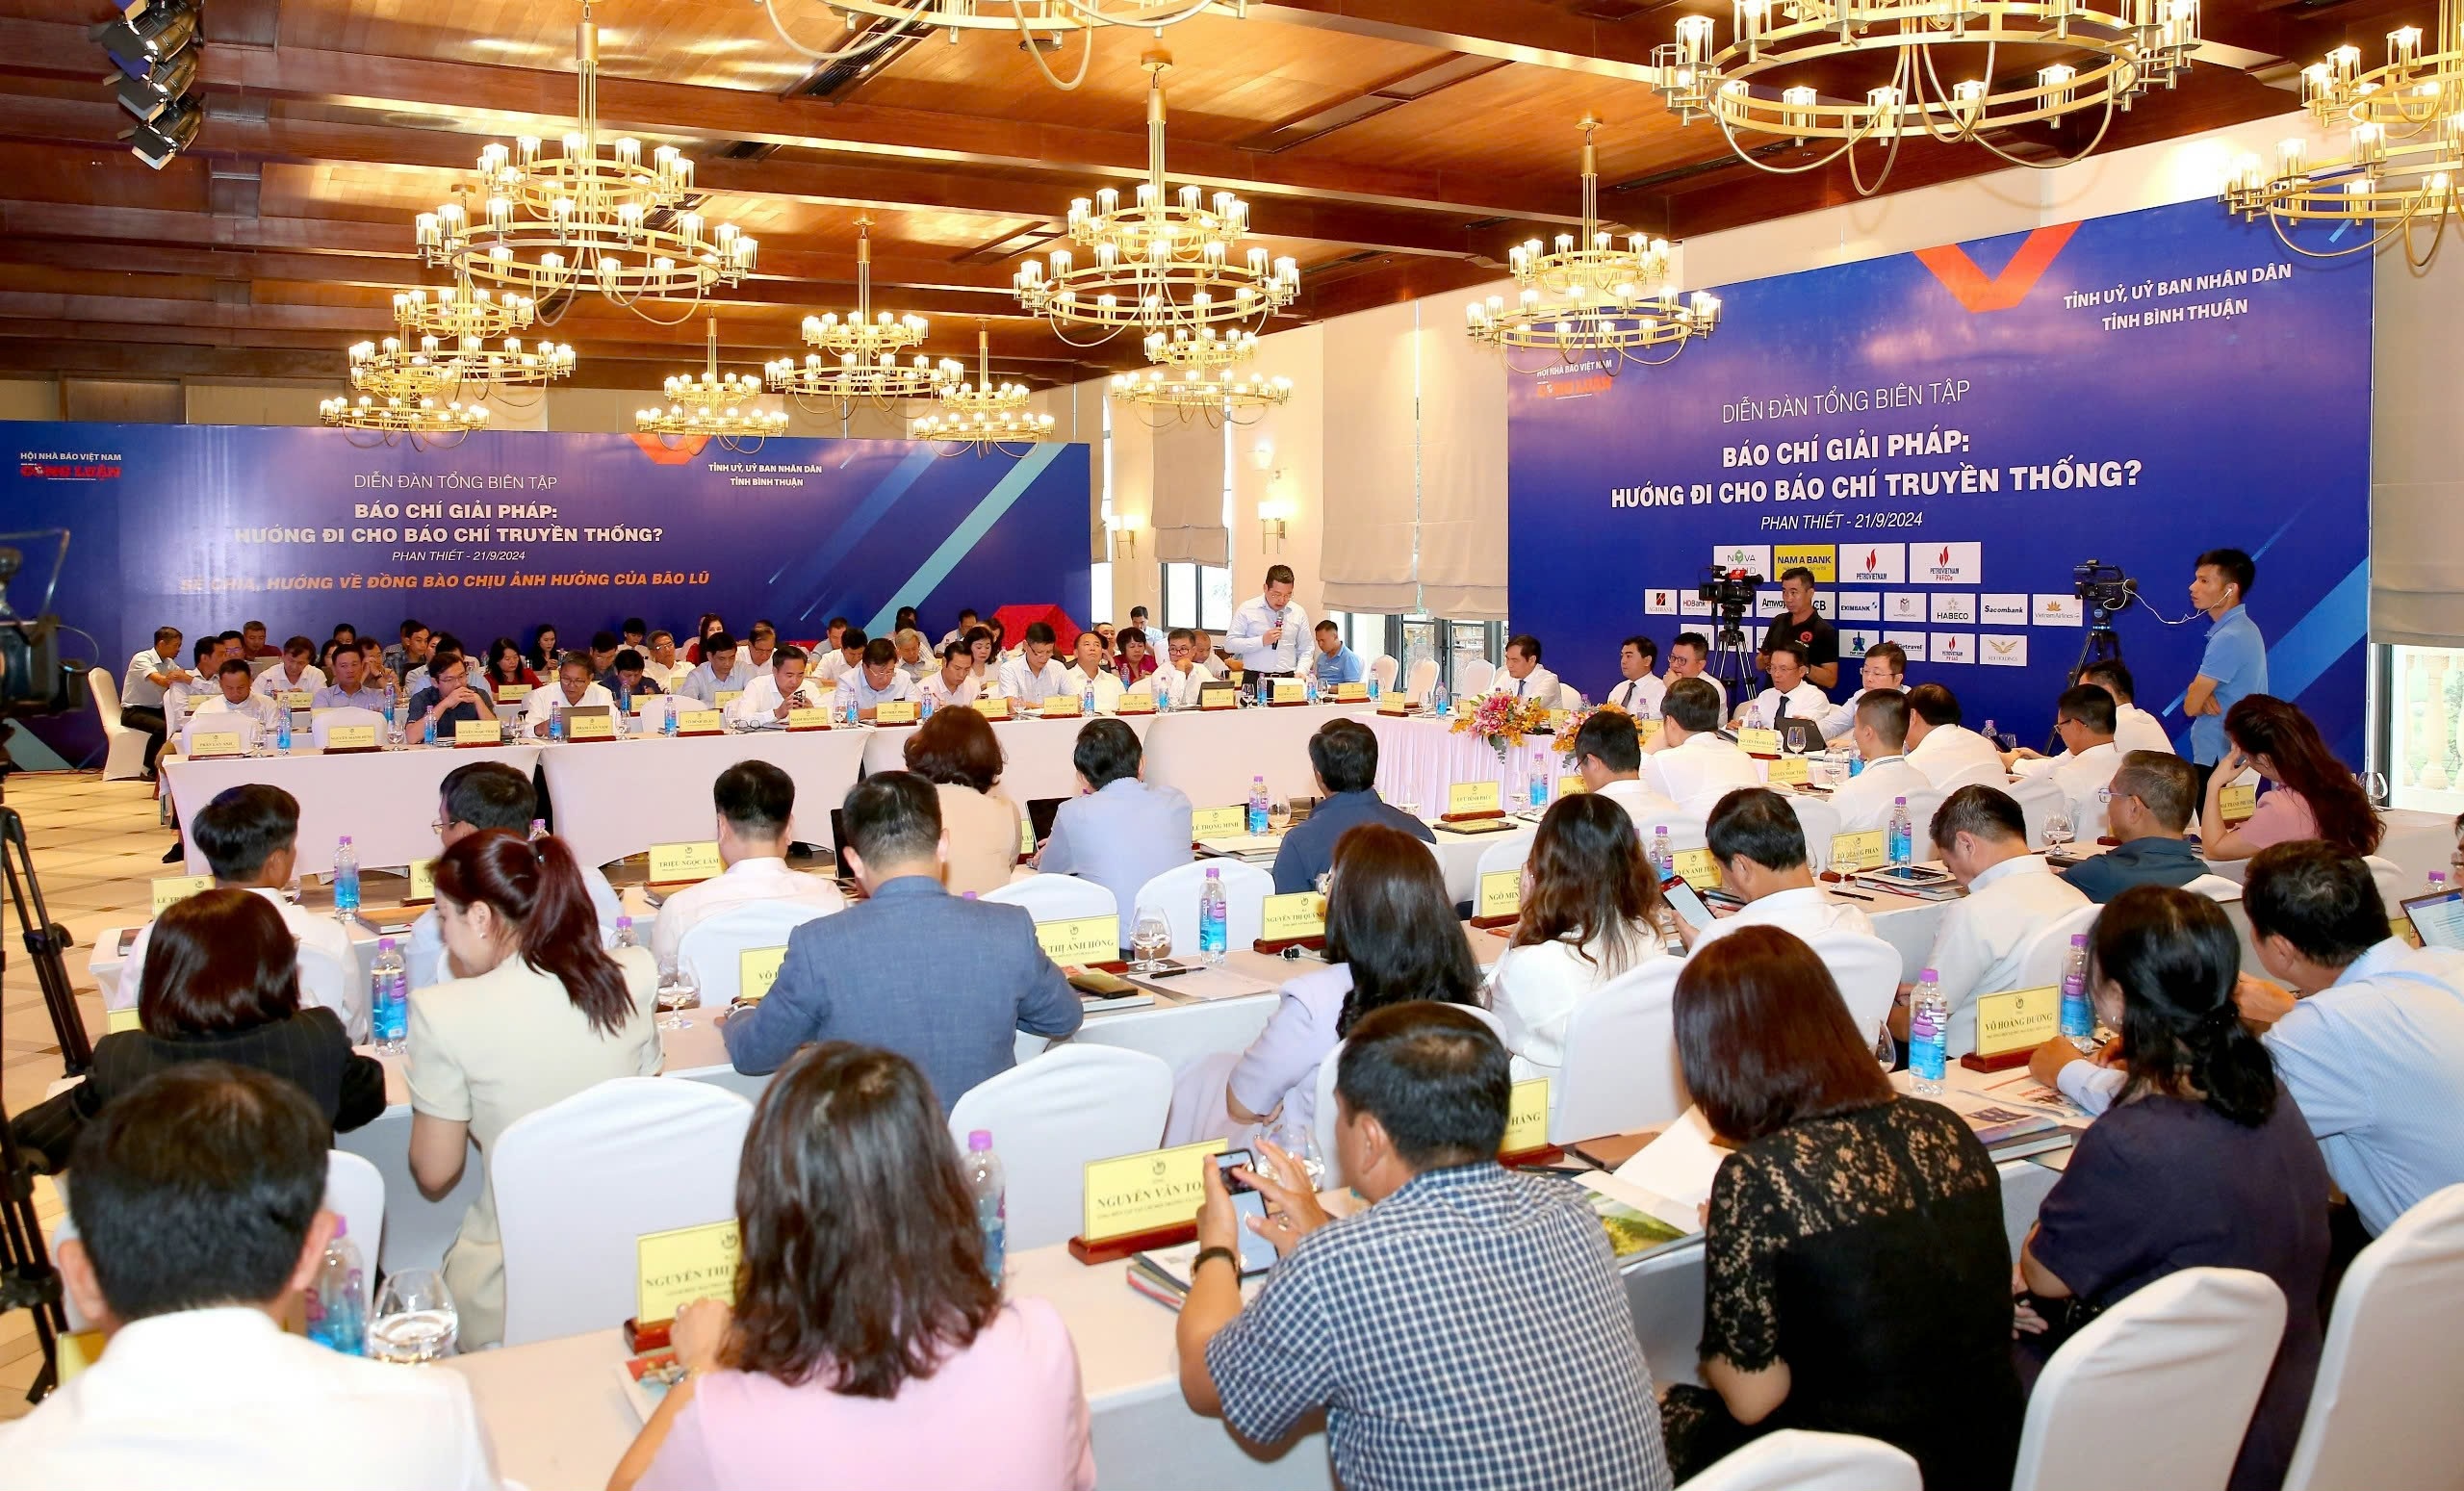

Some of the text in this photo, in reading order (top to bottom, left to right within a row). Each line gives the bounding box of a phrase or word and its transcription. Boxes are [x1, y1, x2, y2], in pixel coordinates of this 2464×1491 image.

[2063, 291, 2100, 309] TỈNH
[2131, 280, 2154, 300] UỶ
[2157, 277, 2193, 296] BAN
[2196, 269, 2247, 294] NHÂN
[2251, 262, 2292, 283] DÂN
[2102, 297, 2248, 331] TỈNH BÌNH THUẬN
[1723, 378, 1970, 424] DIỄN ĐÀN TỔNG BIÊN TẬP
[1723, 424, 1970, 468] BÁO CHÍ GIẢI PHÁP:
[20, 451, 37, 461] HỘI
[38, 451, 58, 460] NHÀ
[80, 452, 99, 462] VIỆT
[708, 462, 729, 472] TỈNH
[759, 464, 777, 473] BAN
[779, 463, 803, 473] NHÂN
[805, 464, 822, 473] DÂN
[354, 471, 557, 491] DIỄN ĐÀN TỔNG BIÊN TẬP
[730, 476, 804, 488] TỈNH BÌNH THUẬN
[1610, 454, 2143, 508] HƯỚNG ĐI CHO BÁO CHÍ TRUYỀN THỐNG?
[354, 500, 558, 519] BÁO CHÍ GIẢI PHÁP:
[1760, 515, 1799, 530] PHAN
[1803, 510, 1845, 529] THIẾT
[1854, 512, 1923, 528] 21/9/2024
[234, 523, 663, 544] HƯỚNG ĐI CHO BÁO CHÍ TRUYỀN THỐNG?
[392, 552, 426, 560] PHAN
[430, 550, 465, 560] THIẾT
[473, 551, 526, 560] 21/9/2024
[1807, 555, 1832, 564] BANK
[267, 574, 334, 590] HƯỚNG
[340, 572, 362, 589] VỀ
[367, 572, 418, 589] ĐỒNG
[423, 572, 459, 588] BÀO
[464, 575, 506, 589] CHỊU
[510, 571, 547, 586] ẢNH
[551, 570, 610, 586] HƯỞNG
[614, 570, 648, 585] CỦA
[652, 571, 685, 585] BÃO
[689, 570, 710, 584] LŨ
[1812, 601, 1826, 611] CB
[1985, 604, 2024, 613] Sacombank
[1097, 1188, 1151, 1208] NGUYỄN
[645, 1268, 702, 1286] NGUYỄN
